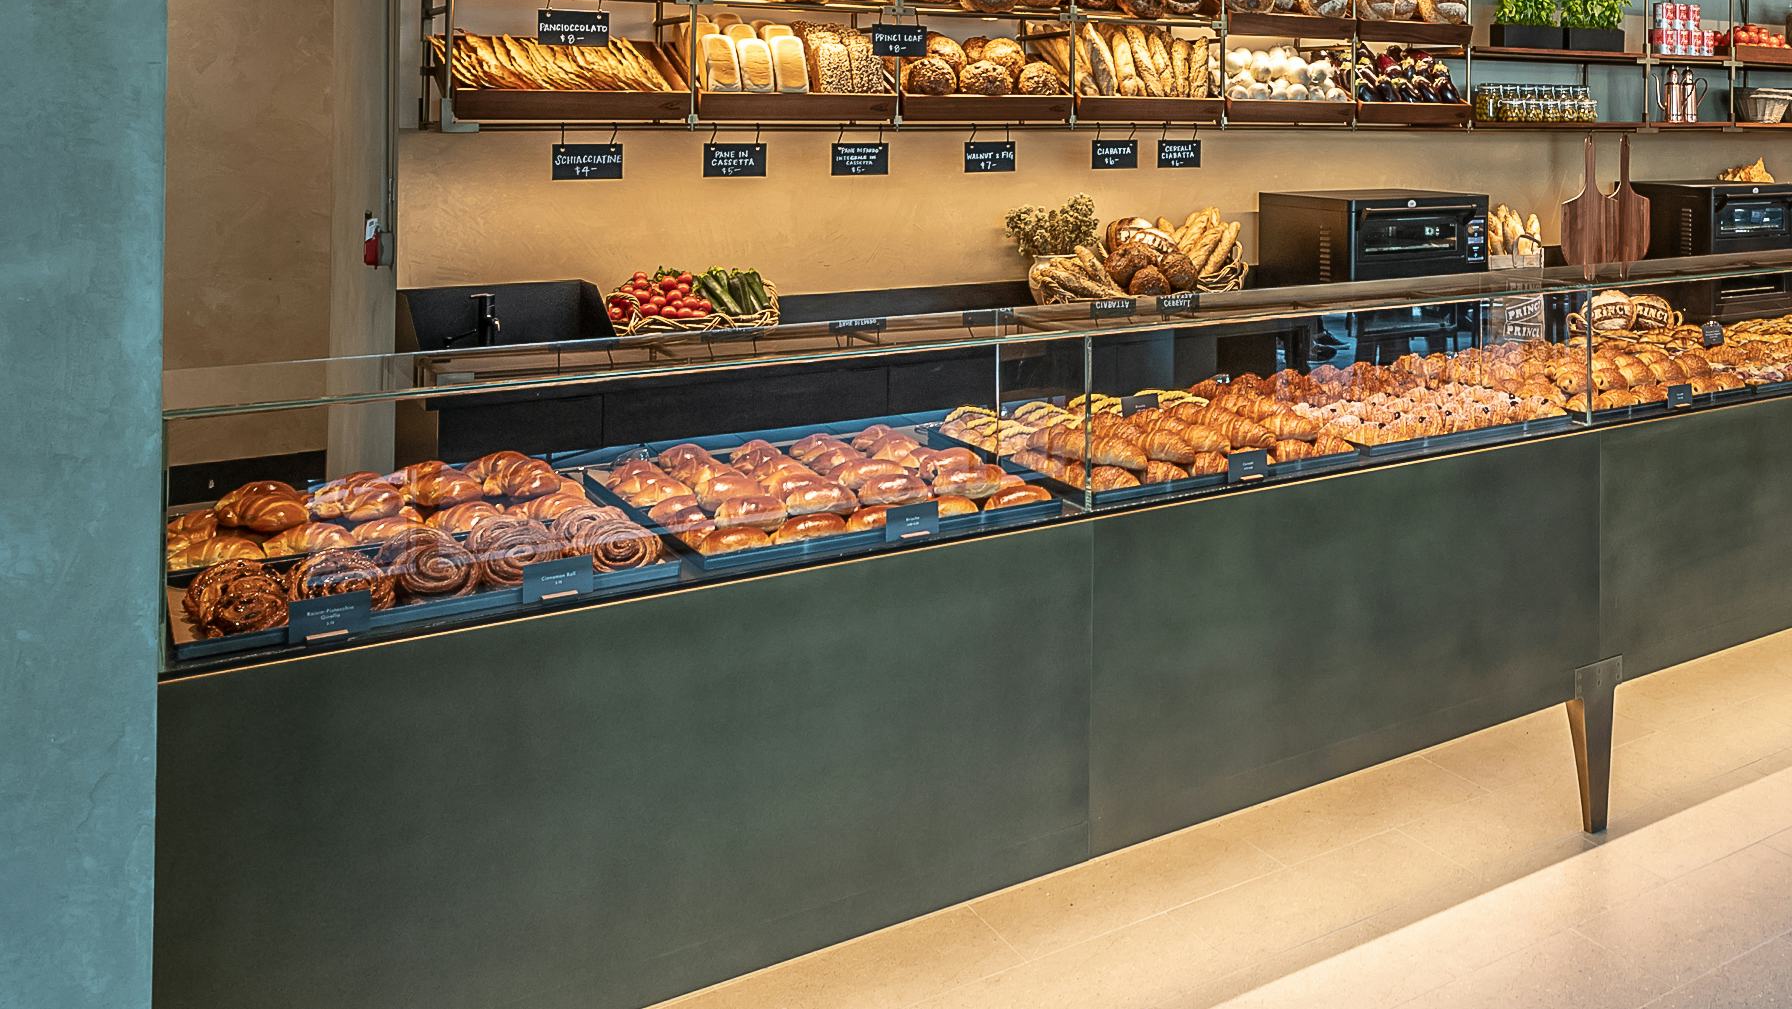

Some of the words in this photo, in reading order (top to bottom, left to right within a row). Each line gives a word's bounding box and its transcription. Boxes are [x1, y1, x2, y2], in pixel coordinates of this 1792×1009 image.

[539, 22, 608, 33] PANCIOCCOLATO
[875, 33, 902, 42] PRINCI
[904, 34, 923, 42] LOAF
[714, 150, 736, 159] PANE
[738, 149, 749, 158] IN
[1096, 146, 1132, 155] CIABATTA
[554, 154, 622, 166] SCHIACCIATINE
[966, 152, 994, 160] WALNUT
[1001, 151, 1014, 160] FIG
[711, 157, 755, 166] CASSETTA
